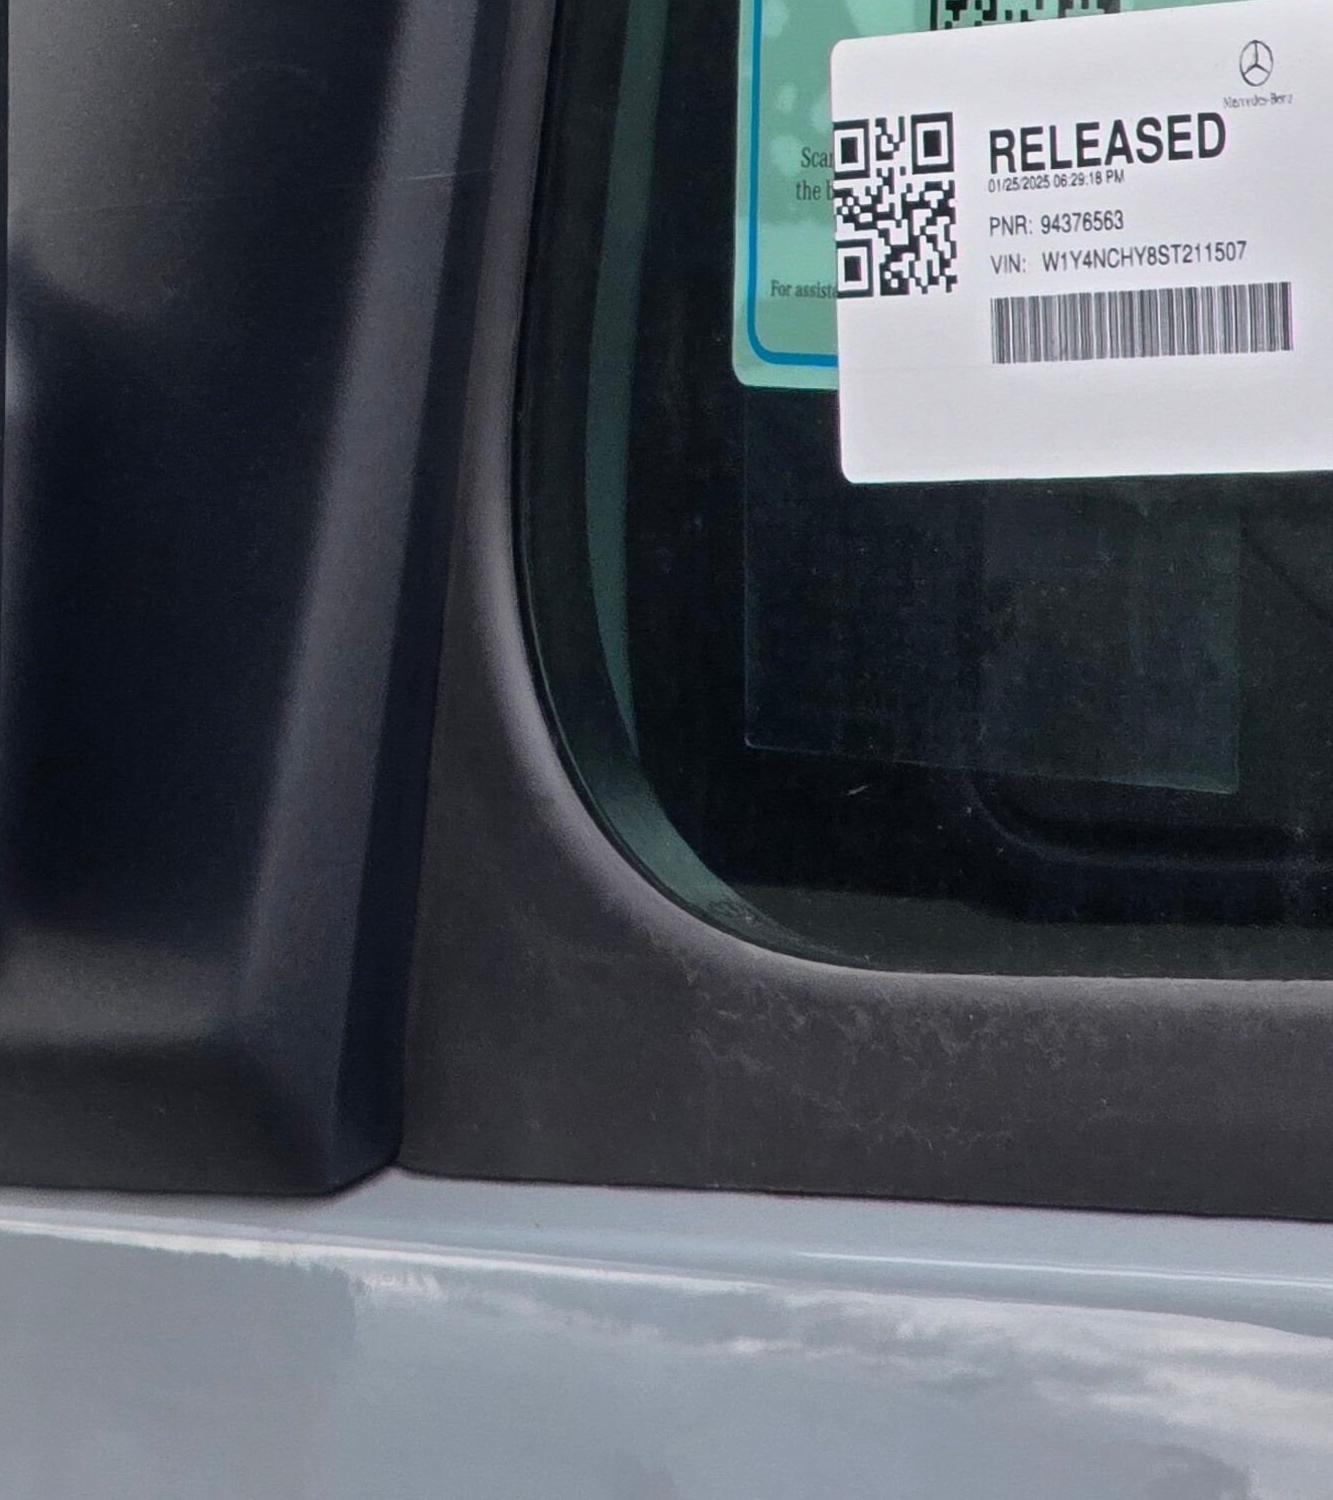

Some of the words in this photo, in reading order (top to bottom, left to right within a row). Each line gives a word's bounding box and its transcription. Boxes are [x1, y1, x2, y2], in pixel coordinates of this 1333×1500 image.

[989, 111, 1226, 174] RELEASED
[795, 179, 822, 201] the
[988, 174, 1050, 193] 01/25/2025
[1053, 171, 1103, 189] 06:29:18
[1106, 169, 1125, 185] PM
[989, 213, 1034, 236] PNR:
[1040, 209, 1124, 235] 94376563
[990, 252, 1027, 275] VIN:
[1042, 240, 1247, 273] W1Y4NCHY8ST211507
[770, 279, 792, 297] For
